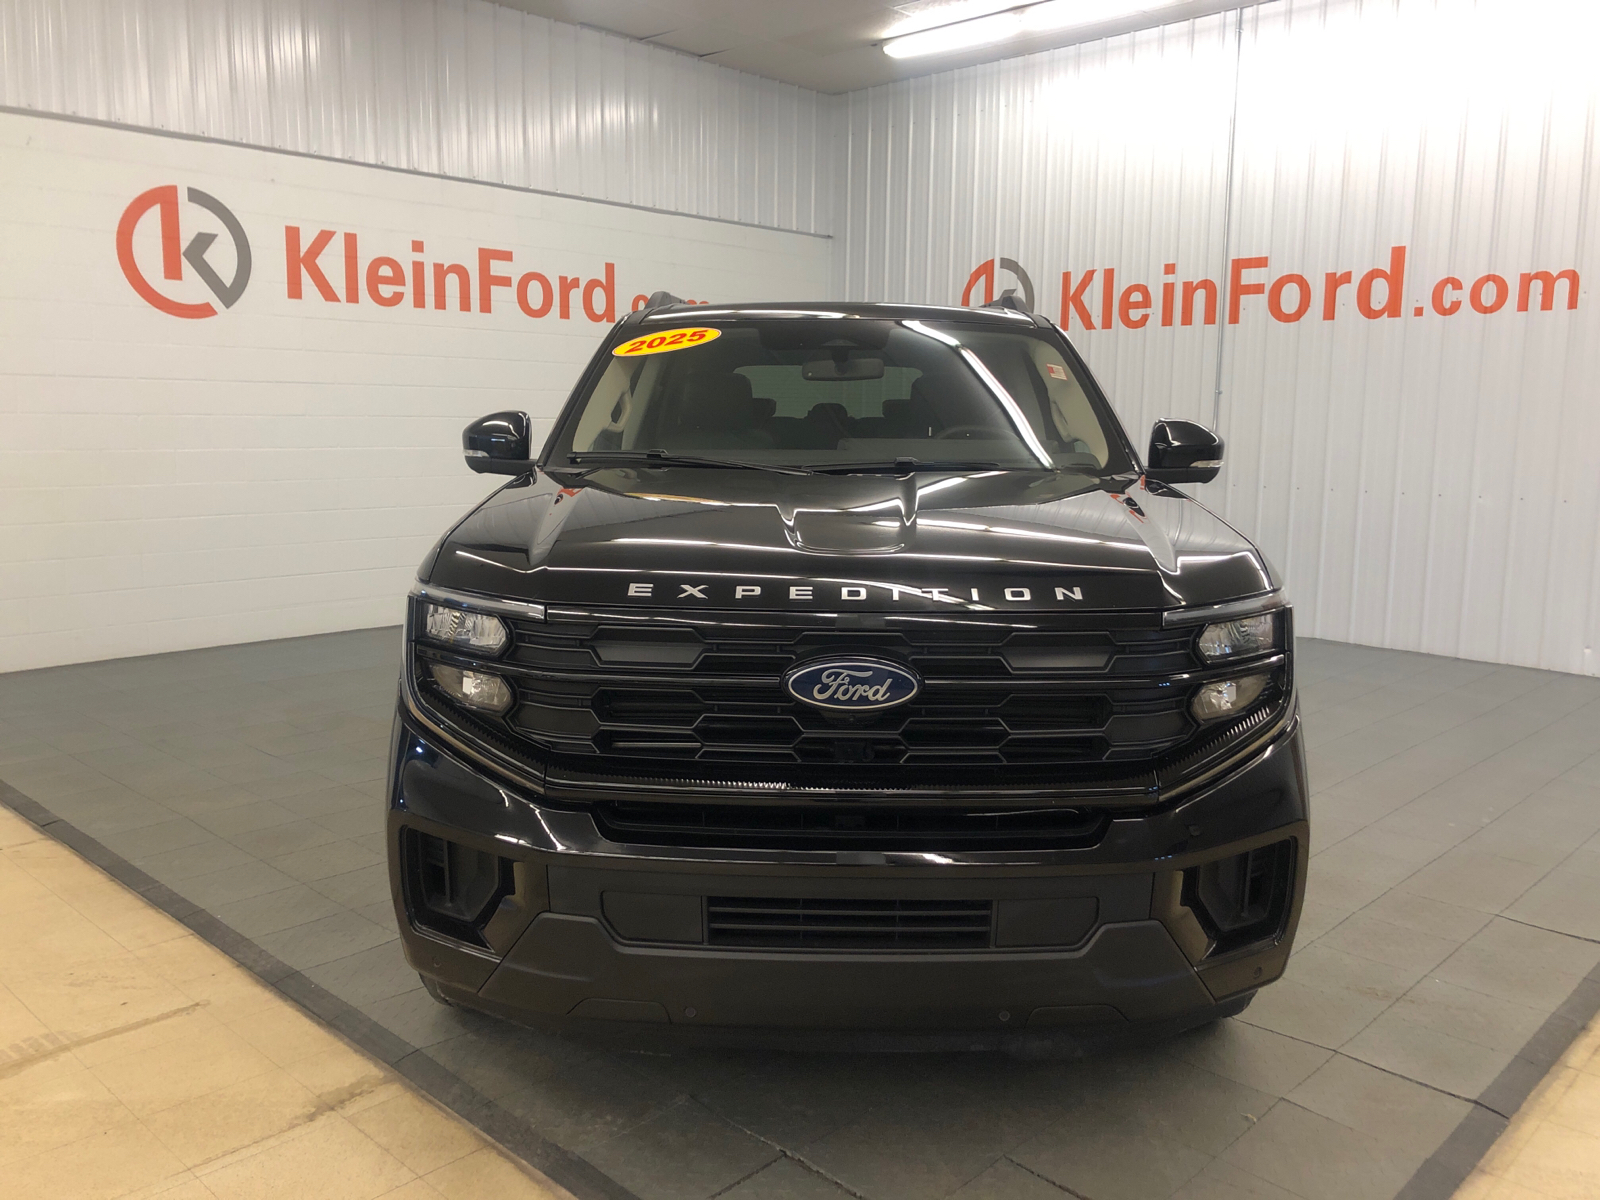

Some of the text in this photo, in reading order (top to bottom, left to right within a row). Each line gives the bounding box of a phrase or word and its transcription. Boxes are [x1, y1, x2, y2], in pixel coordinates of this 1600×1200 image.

[285, 225, 710, 324] KleinFord
[1060, 246, 1580, 331] KleinFord.com
[624, 329, 708, 354] 2025
[627, 582, 1083, 601] EXPEDITION
[813, 668, 893, 701] Ford
